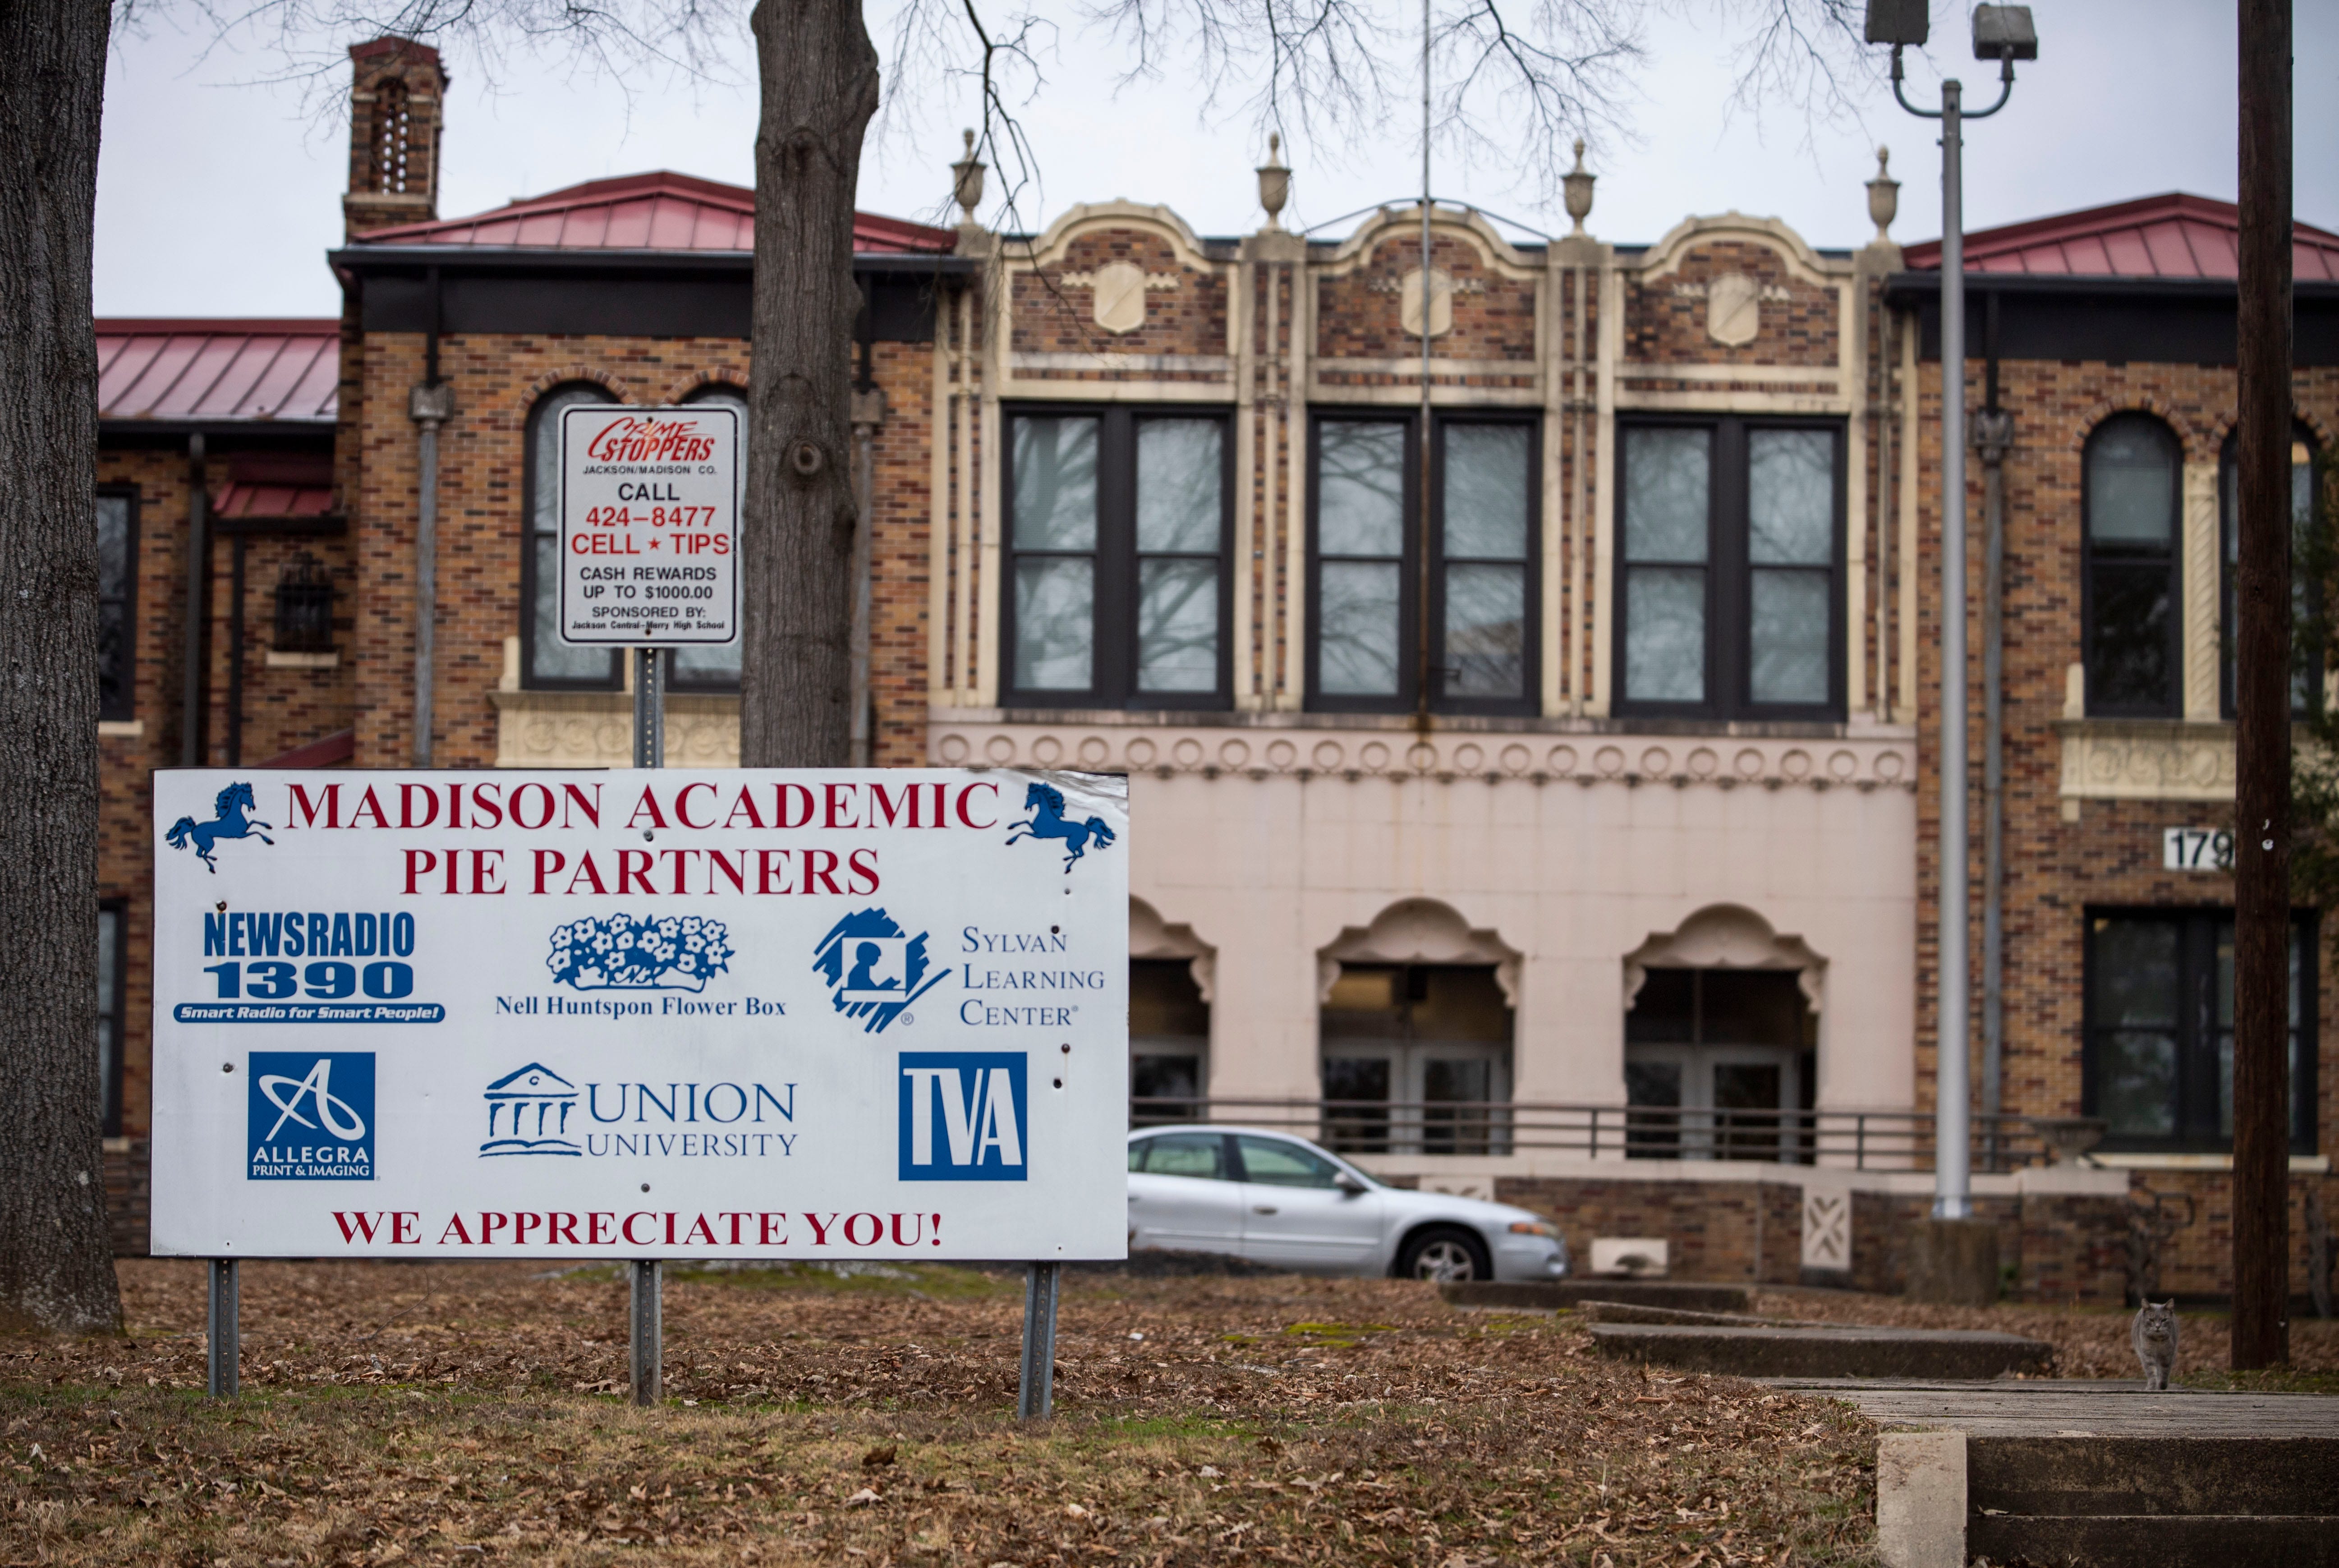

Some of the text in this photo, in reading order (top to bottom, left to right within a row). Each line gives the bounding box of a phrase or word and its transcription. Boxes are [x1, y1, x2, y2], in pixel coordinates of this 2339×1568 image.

[601, 437, 715, 462] STOPPERS
[583, 465, 717, 475] JACKSON/MADISON CO.
[618, 482, 680, 501] CALL
[586, 506, 716, 527] 424-8477
[571, 533, 730, 555] CELL TIPS
[579, 566, 717, 581] CASH REWARDS
[583, 584, 713, 600] UP TO $1000.00
[592, 606, 706, 618] SPONSORED BY:
[571, 621, 607, 630] Jackson
[673, 621, 692, 630] High
[696, 621, 725, 629] School
[284, 782, 998, 829] MADISON ACADEMIC
[400, 848, 880, 896] PIE PARTNERS
[204, 911, 415, 957] NEWSRADIO
[962, 926, 1067, 953] SYLVAN
[203, 961, 414, 999] 1390
[964, 963, 1104, 989] LEARNING
[181, 1007, 438, 1021] Smart Radio for Smart People!
[496, 996, 786, 1020] Nell Huntspon Flower Box
[585, 1082, 798, 1123] UNION
[903, 1068, 1023, 1166] TVA
[253, 1146, 369, 1163] ALLEGRA
[587, 1134, 797, 1156] UNIVERSITY
[253, 1165, 369, 1176] PRINT & IMAGING
[331, 1211, 941, 1246] WE APPRECIATE YOU!
